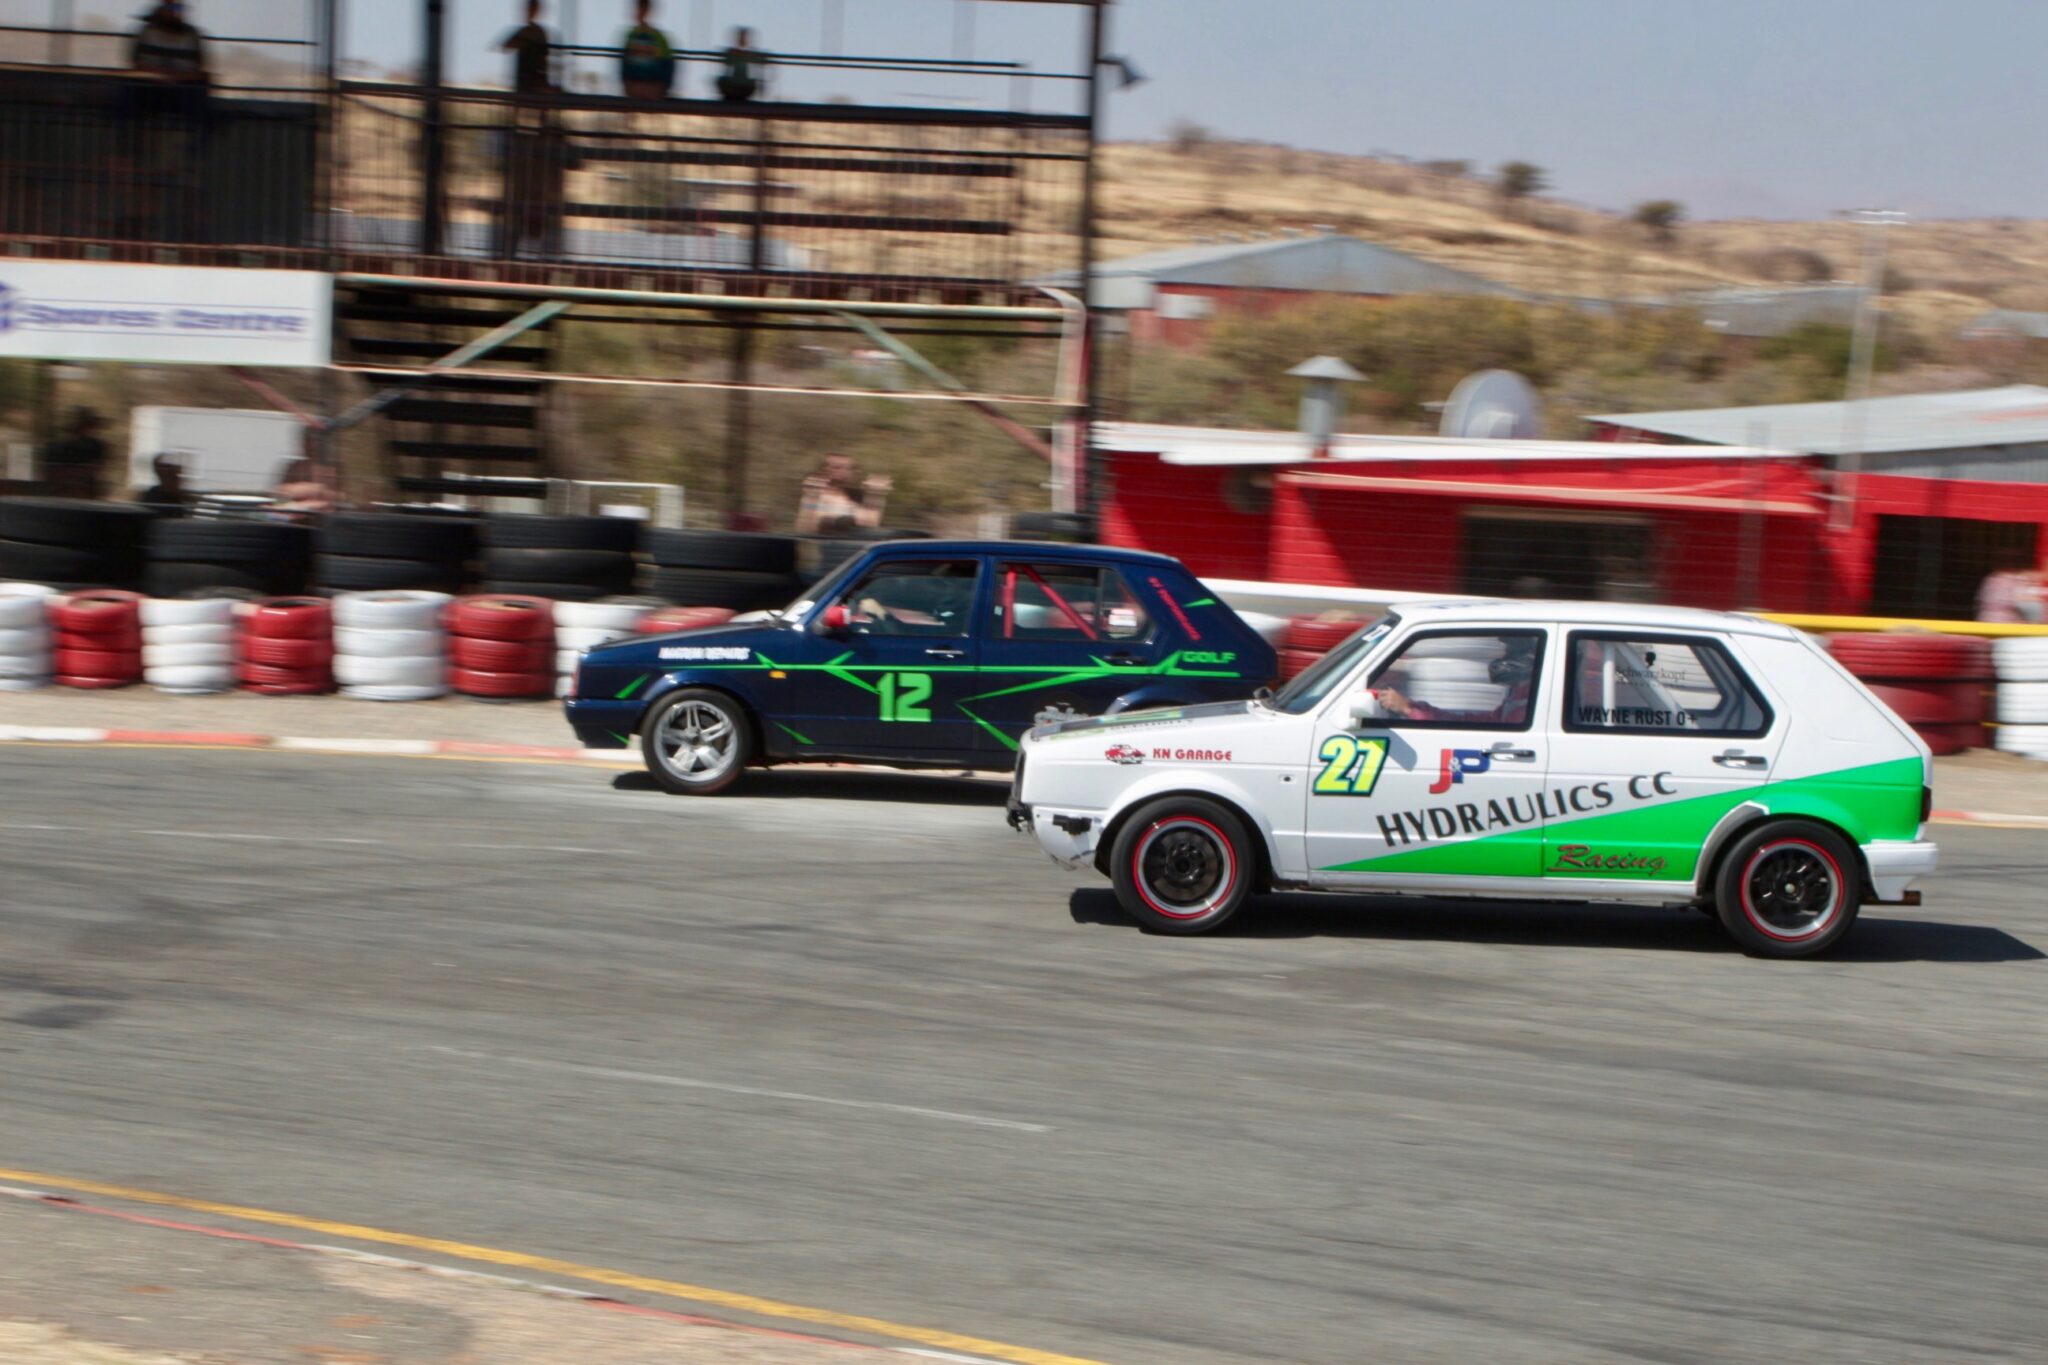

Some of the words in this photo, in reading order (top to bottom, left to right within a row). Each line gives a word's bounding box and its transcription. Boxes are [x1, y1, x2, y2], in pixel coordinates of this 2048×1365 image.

[876, 672, 933, 722] 12
[1579, 706, 1632, 725] WAYNE
[1635, 709, 1672, 726] RUST
[1152, 748, 1172, 760] KN
[1174, 748, 1233, 762] GARAGE
[1313, 735, 1391, 796] 27
[1375, 781, 1614, 848] HYDRAULICS
[1627, 771, 1678, 801] CC
[1552, 843, 1666, 876] Racing
